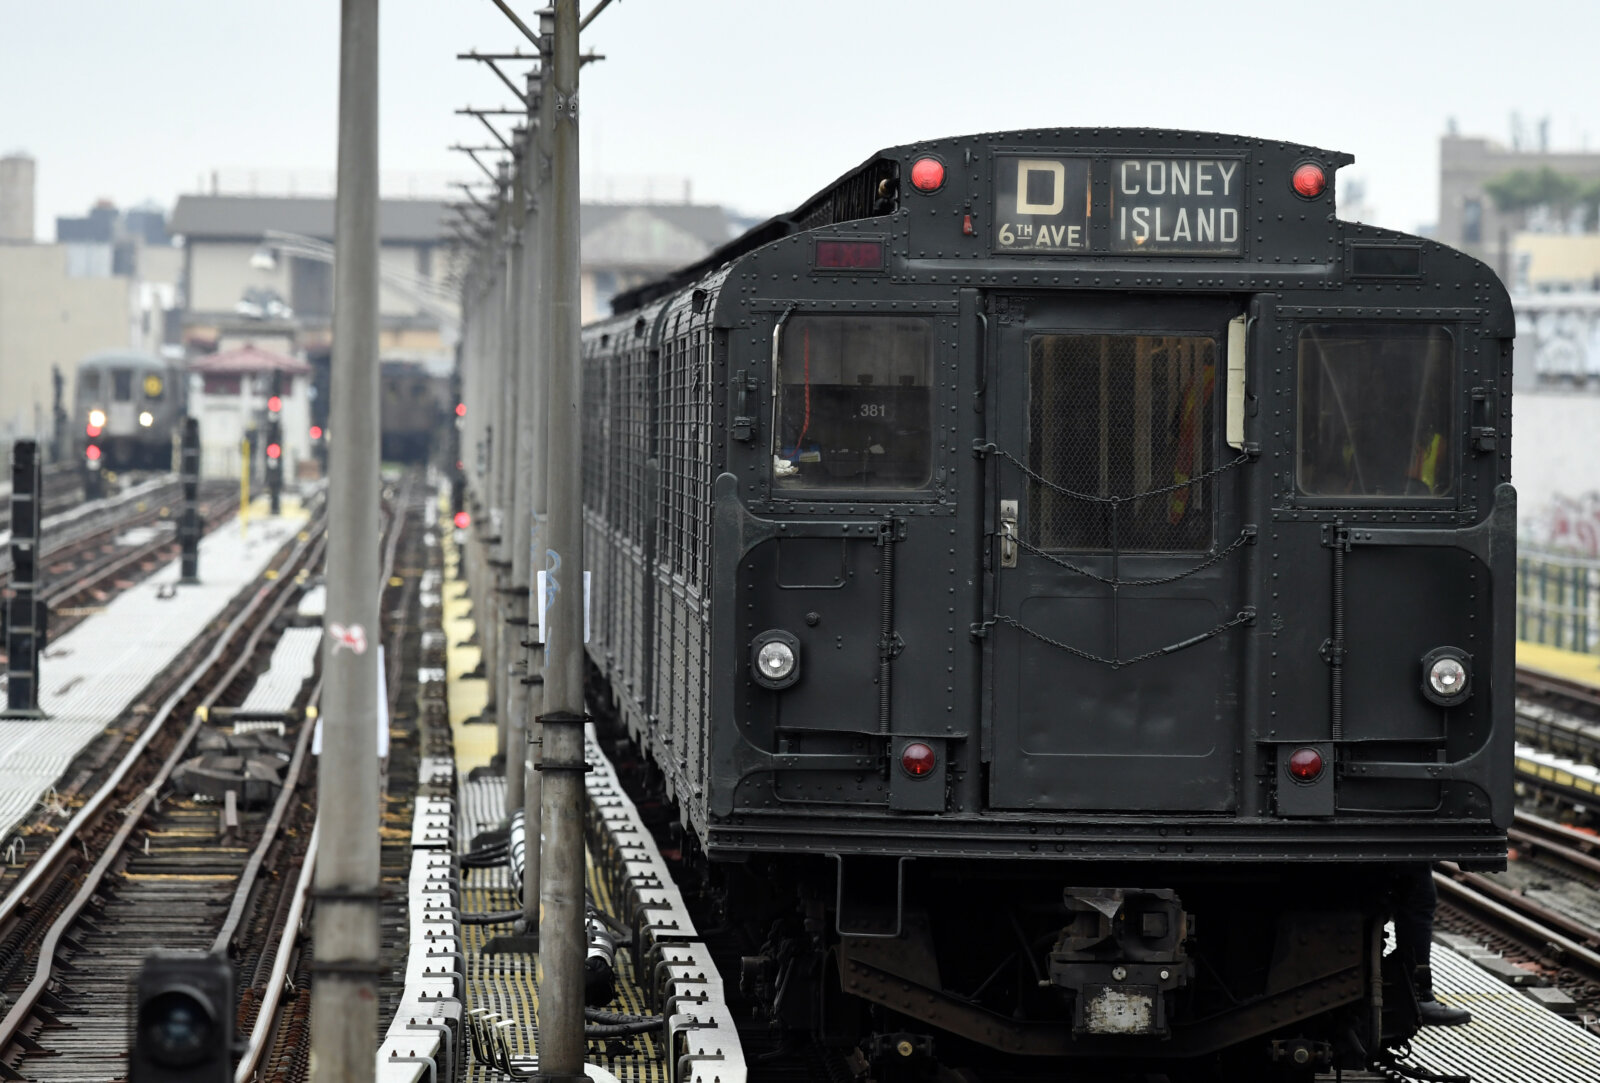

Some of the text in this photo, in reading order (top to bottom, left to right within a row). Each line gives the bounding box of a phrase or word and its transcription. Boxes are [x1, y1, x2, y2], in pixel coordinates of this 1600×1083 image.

[1016, 159, 1065, 216] D
[1120, 160, 1238, 196] CONEY
[999, 223, 1033, 246] 6TH
[1120, 206, 1239, 243] ISLAND
[860, 403, 886, 418] 381
